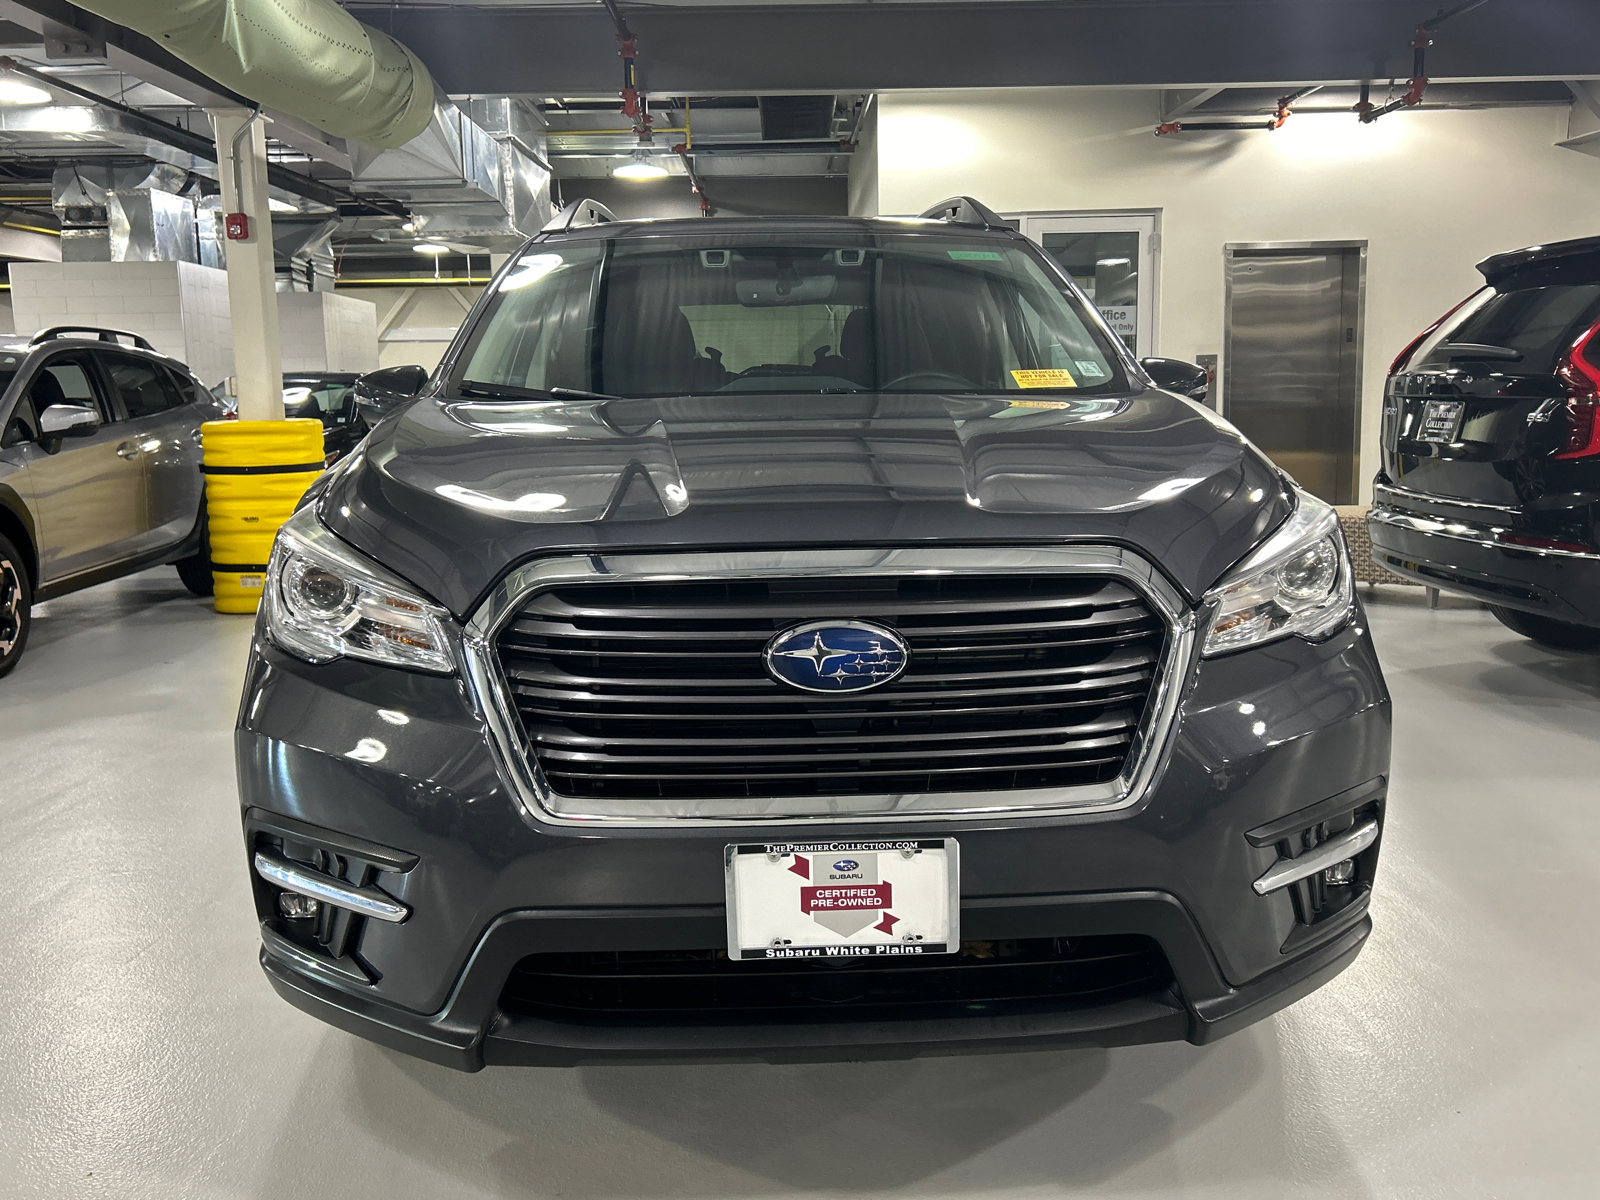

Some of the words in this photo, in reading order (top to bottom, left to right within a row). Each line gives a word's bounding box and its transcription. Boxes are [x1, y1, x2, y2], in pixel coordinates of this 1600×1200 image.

[1101, 309, 1127, 321] ffice
[1118, 323, 1134, 331] Only
[816, 888, 876, 898] CERTIFIED
[810, 898, 882, 907] PRE-OWNED
[765, 948, 820, 958] Subaru
[825, 946, 870, 956] White
[875, 945, 923, 955] Plains
